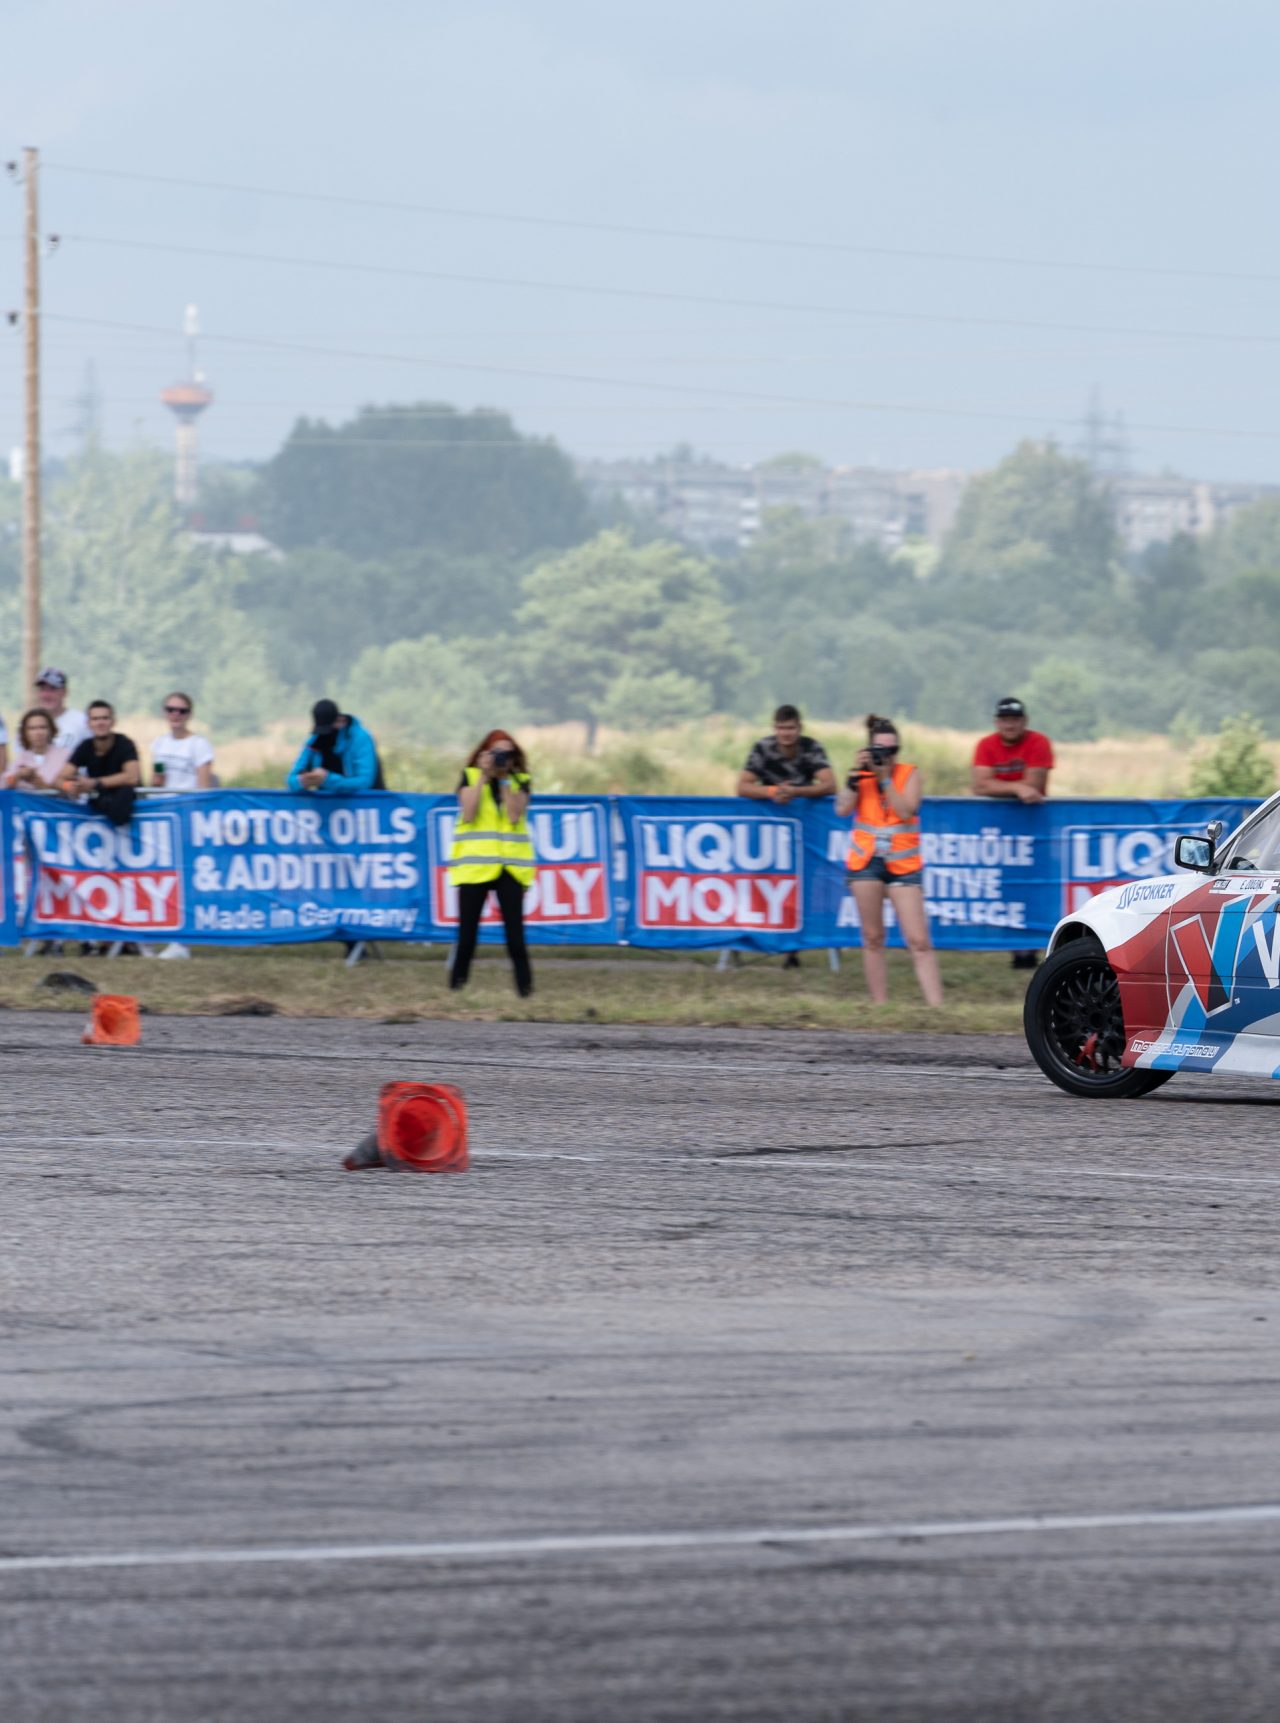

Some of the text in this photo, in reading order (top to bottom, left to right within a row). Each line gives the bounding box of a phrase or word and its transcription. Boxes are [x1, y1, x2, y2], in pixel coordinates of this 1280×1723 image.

[31, 820, 173, 870] LIQUI
[191, 807, 417, 847] MOTOR OILS
[641, 822, 792, 872] LIQUI
[192, 852, 419, 892] & ADDITIVES
[1132, 883, 1175, 902] STOKKER
[38, 874, 178, 924] MOLY
[194, 902, 419, 932] Made in Germany
[646, 876, 797, 925] MOLY
